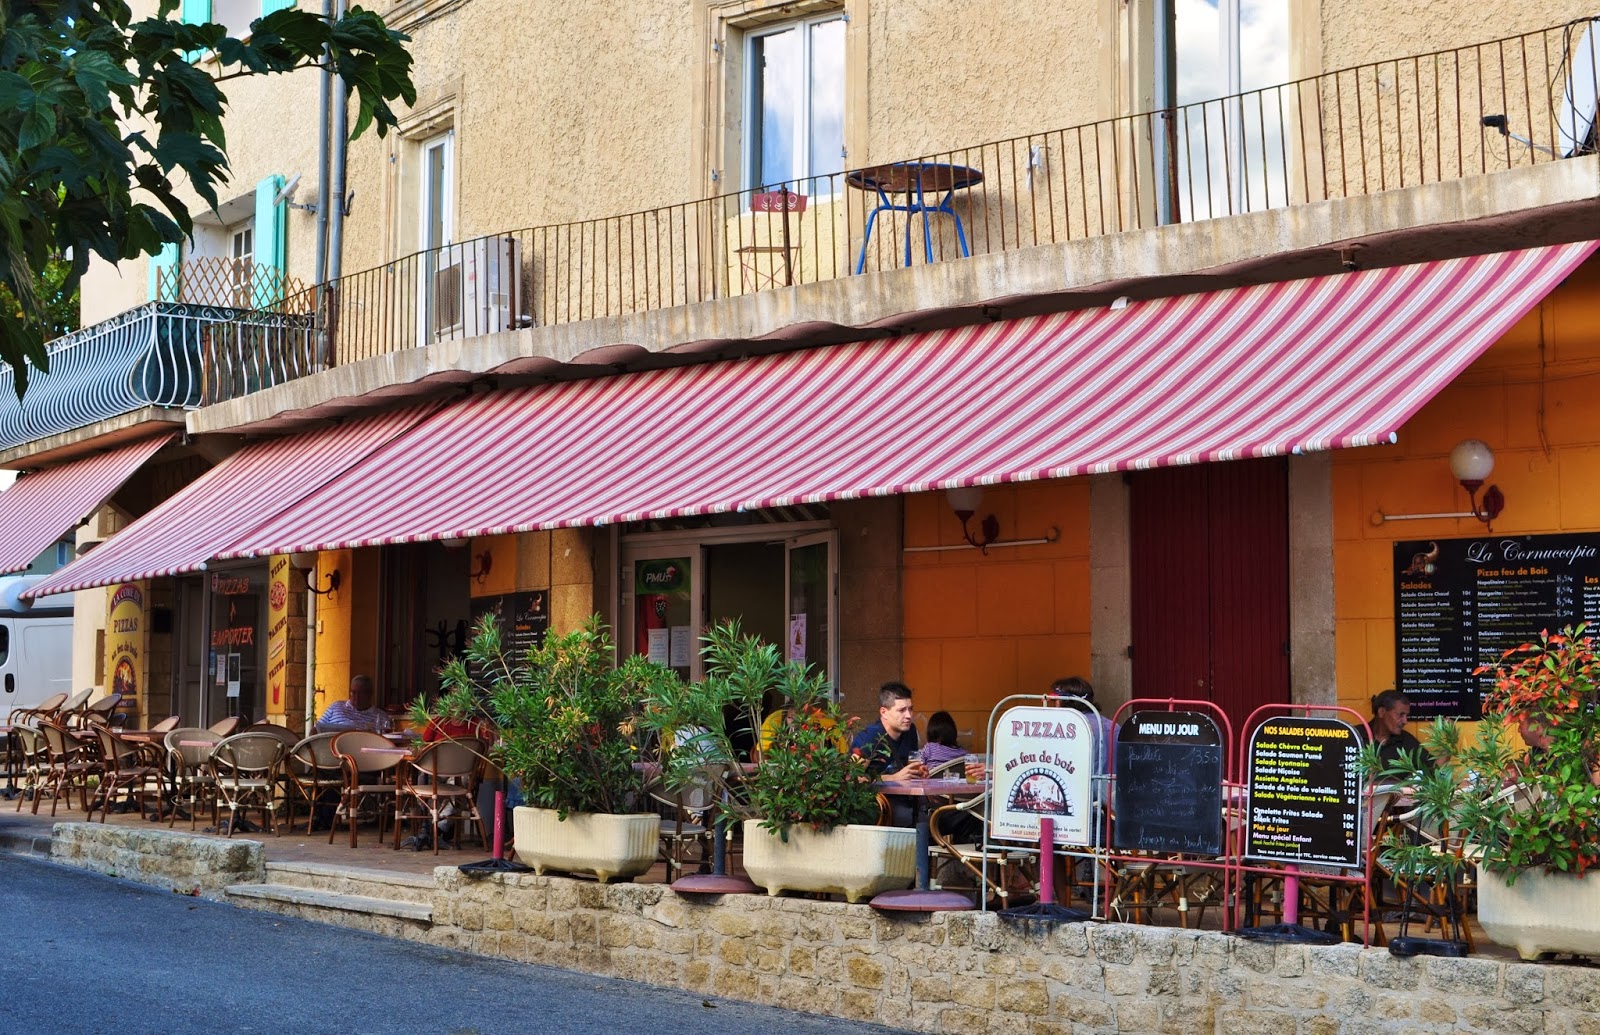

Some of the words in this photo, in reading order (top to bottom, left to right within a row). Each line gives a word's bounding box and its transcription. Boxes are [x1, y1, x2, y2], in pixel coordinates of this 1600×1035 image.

[1465, 542, 1494, 563] La
[270, 558, 287, 579] PIZZA
[1502, 568, 1515, 576] feu
[1517, 567, 1528, 576] de
[1530, 566, 1548, 575] Bois
[646, 572, 666, 583] PMU
[1584, 576, 1598, 584] Les
[218, 577, 250, 595] PIZZAS
[1401, 582, 1432, 590] Salades
[113, 618, 138, 634] PIZZAS
[212, 627, 254, 646] EMPORTER
[268, 659, 285, 680] FRITES
[1012, 720, 1077, 740] PIZZAS
[1139, 723, 1162, 735] MENU
[1164, 724, 1176, 735] DU
[1177, 724, 1199, 736] JOUR
[1264, 726, 1277, 735] NOS
[1279, 726, 1304, 736] SALADES
[1305, 728, 1349, 738] GOURMANDES
[1279, 743, 1300, 751] Chèvre
[1302, 744, 1322, 752] Chaud
[1256, 750, 1277, 758] Salade
[1305, 752, 1322, 760] Fumé
[1005, 758, 1018, 772] au
[1020, 752, 1037, 764] feu
[1039, 750, 1052, 763] de
[1054, 753, 1075, 774] bois
[1278, 759, 1310, 768] Lyonnaise
[1278, 768, 1300, 776] Niçoise
[1280, 776, 1308, 784] Anglaise
[1286, 784, 1300, 792] Foie
[1311, 786, 1338, 795] volailles
[1276, 792, 1316, 802] Végétarienne
[1254, 807, 1281, 816] Omelette
[1271, 834, 1291, 842] spécial
